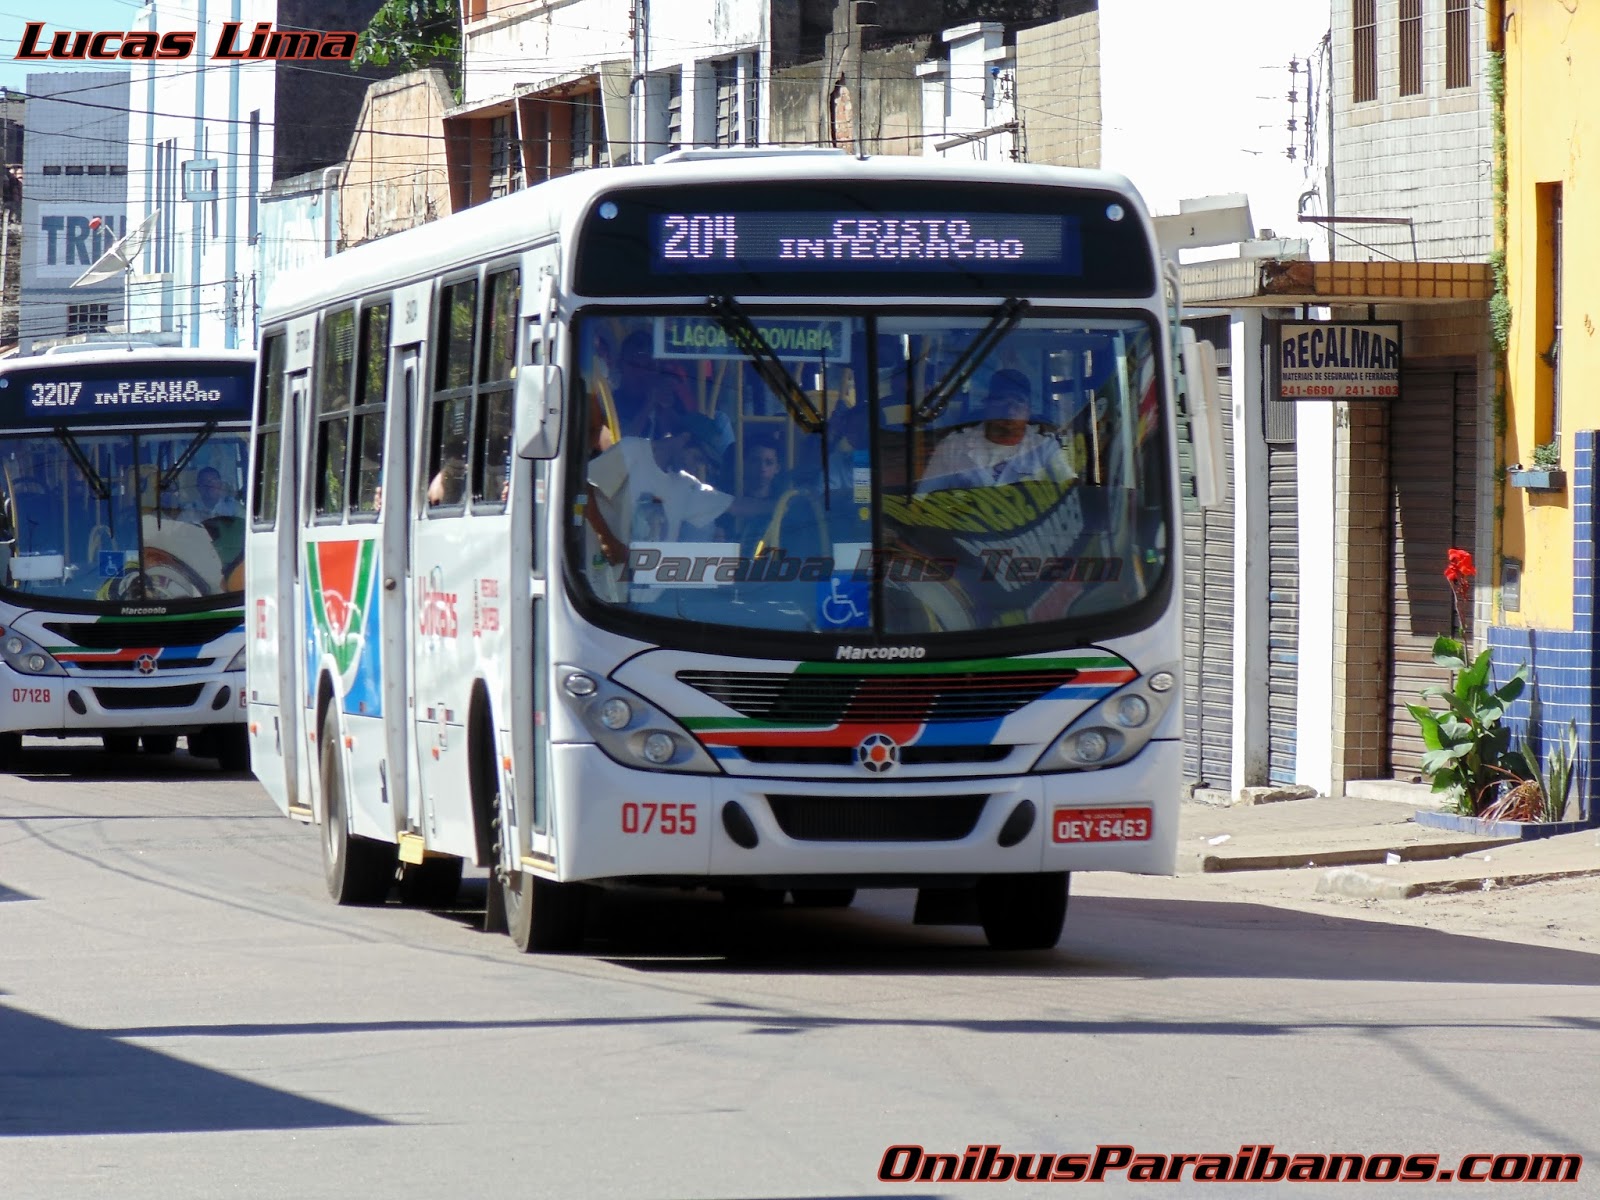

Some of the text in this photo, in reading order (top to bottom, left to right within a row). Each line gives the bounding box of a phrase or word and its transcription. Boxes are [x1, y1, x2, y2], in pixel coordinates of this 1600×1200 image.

[664, 215, 738, 259] 204
[832, 219, 970, 240] CRISTO
[1282, 327, 1398, 368] RECALMAR
[31, 382, 82, 406] 3207
[118, 380, 199, 394] PENHA
[1281, 385, 1335, 396] 241-6690
[121, 606, 167, 615] Marcopolo
[836, 645, 926, 660] Marcopolo
[12, 688, 50, 703] 07128
[622, 802, 697, 835] 0755
